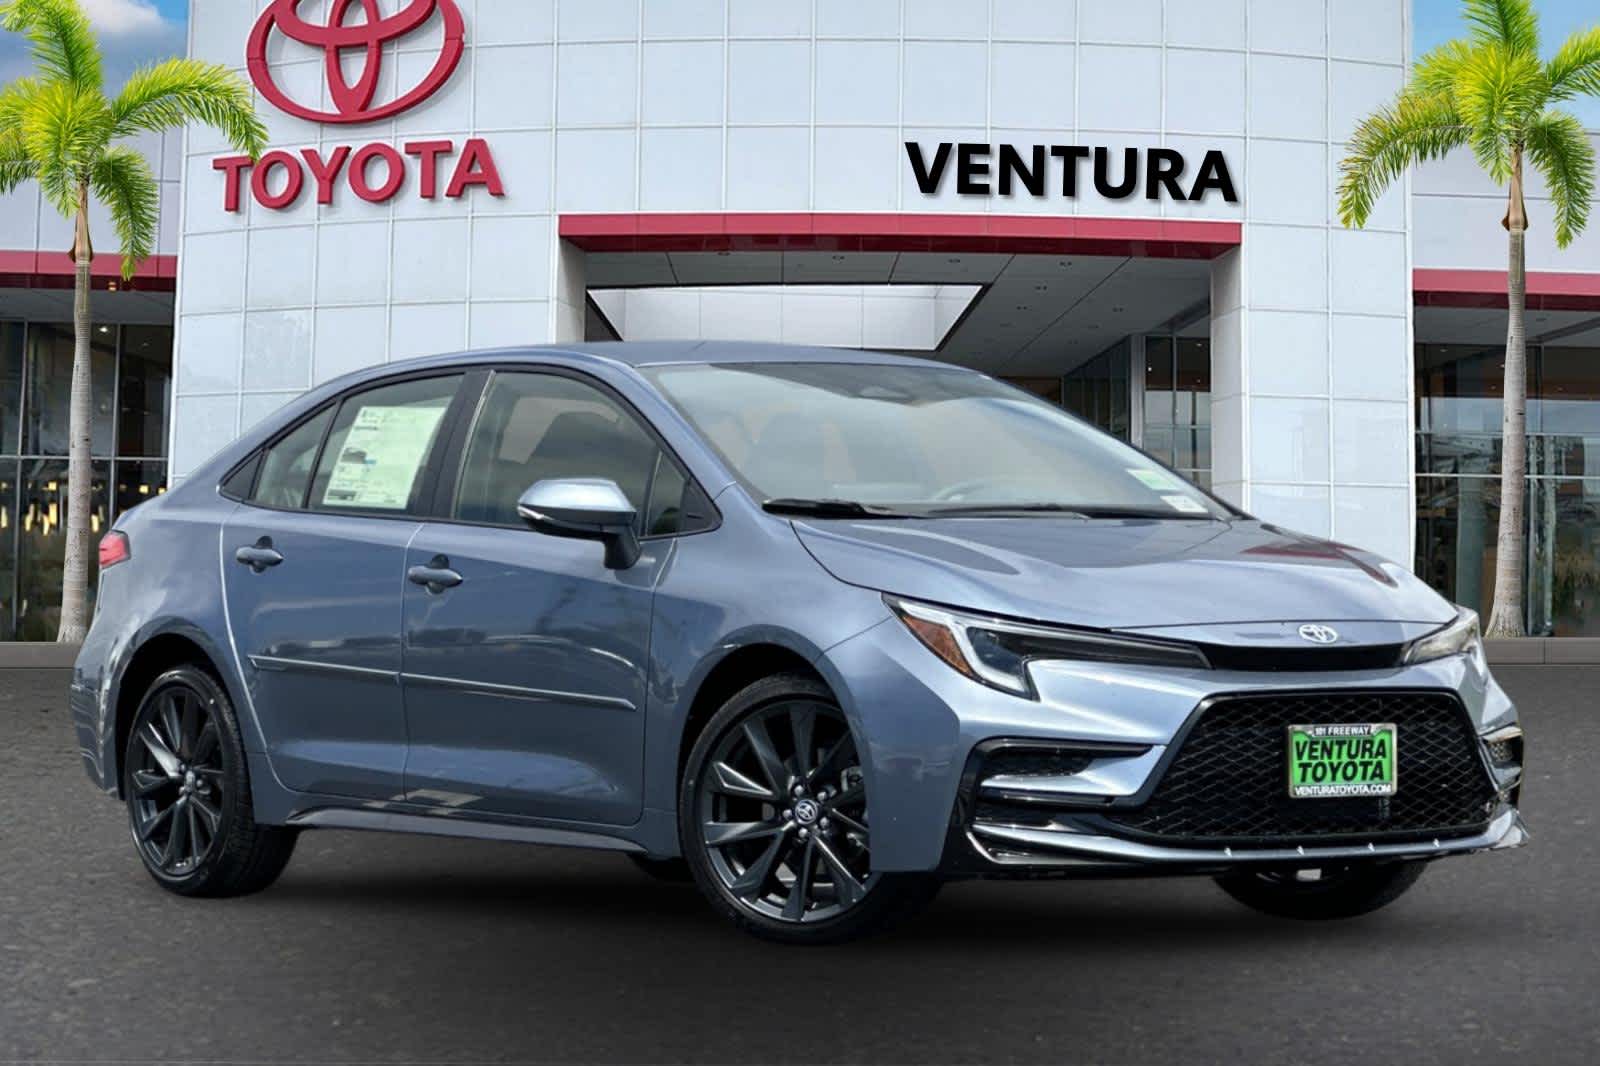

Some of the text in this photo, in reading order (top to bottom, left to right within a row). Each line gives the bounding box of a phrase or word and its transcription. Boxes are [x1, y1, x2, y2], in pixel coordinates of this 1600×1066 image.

[212, 138, 505, 212] TOYOTA
[904, 142, 1239, 202] VENTURA
[1328, 726, 1369, 735] FREEWAY
[1295, 739, 1386, 760] VENTURA
[1298, 761, 1385, 783] TOYOTA
[1295, 784, 1392, 796] VENTURATOYOTA.COM
